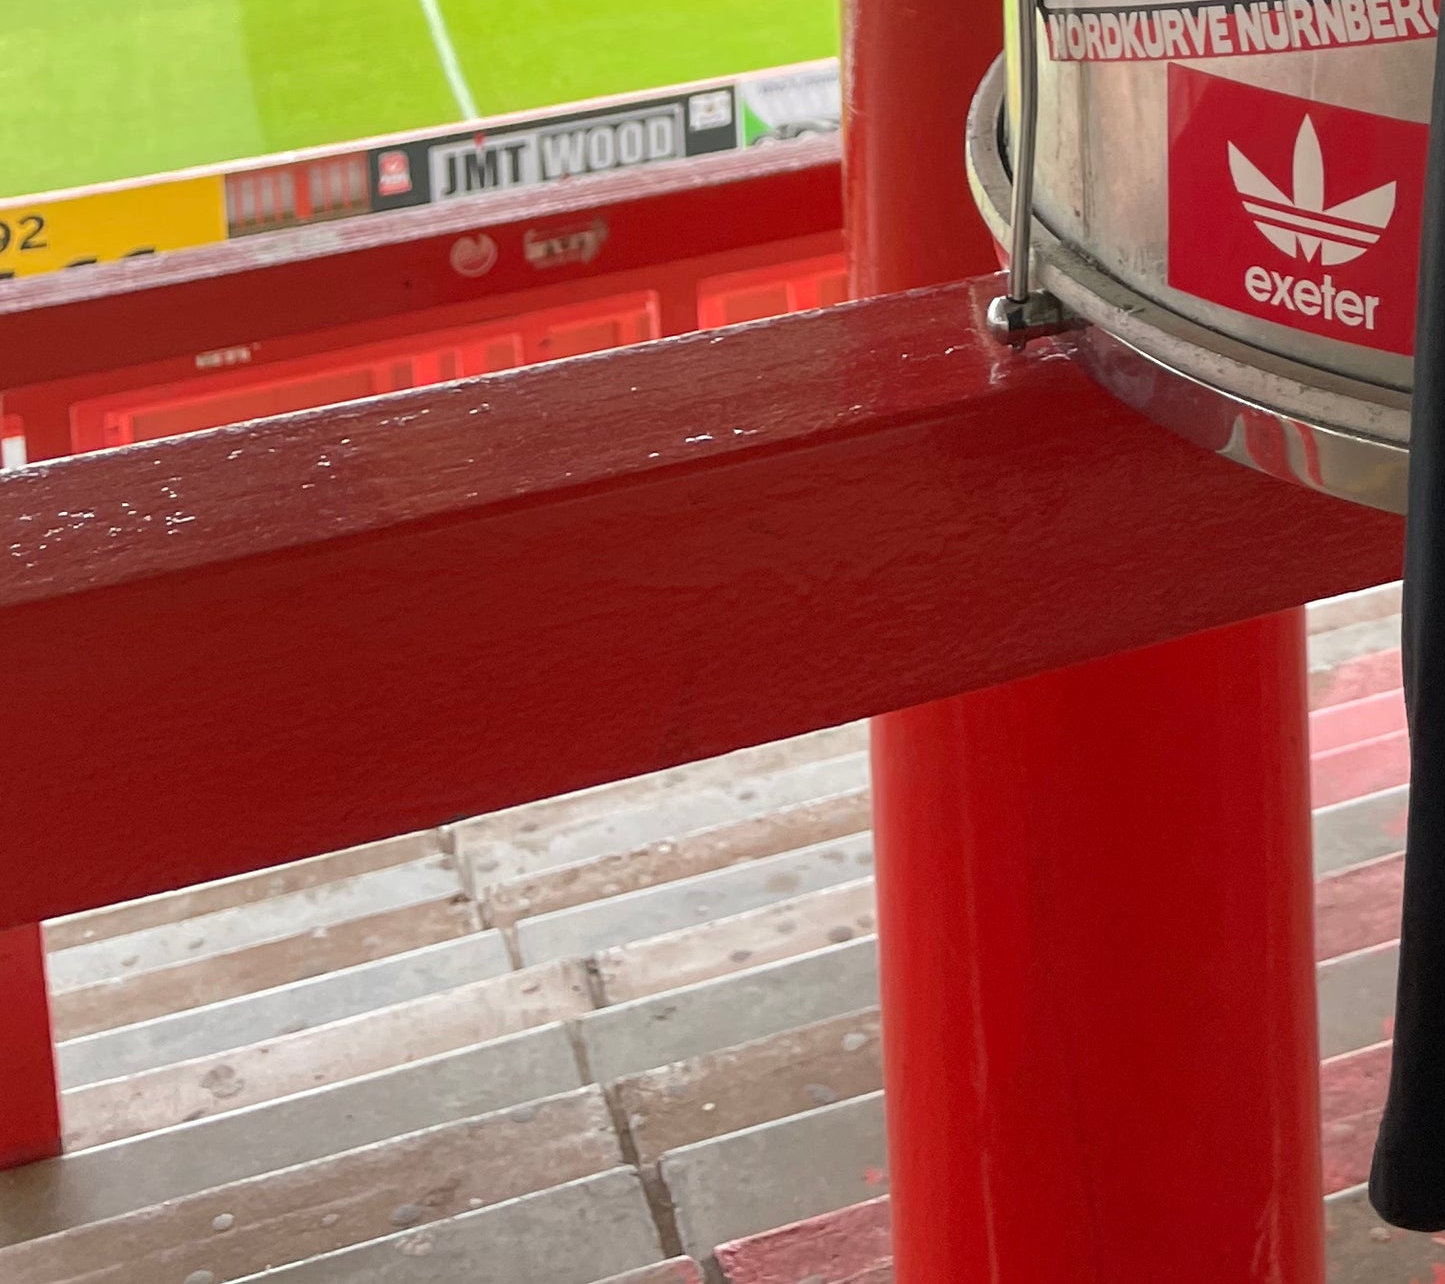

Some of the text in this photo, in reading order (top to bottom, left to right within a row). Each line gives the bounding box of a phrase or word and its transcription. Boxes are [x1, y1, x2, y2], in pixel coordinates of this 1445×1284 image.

[1048, 4, 1234, 61] NORDKURVE
[444, 115, 674, 195] JMT WOOD
[1244, 265, 1380, 331] exeter
